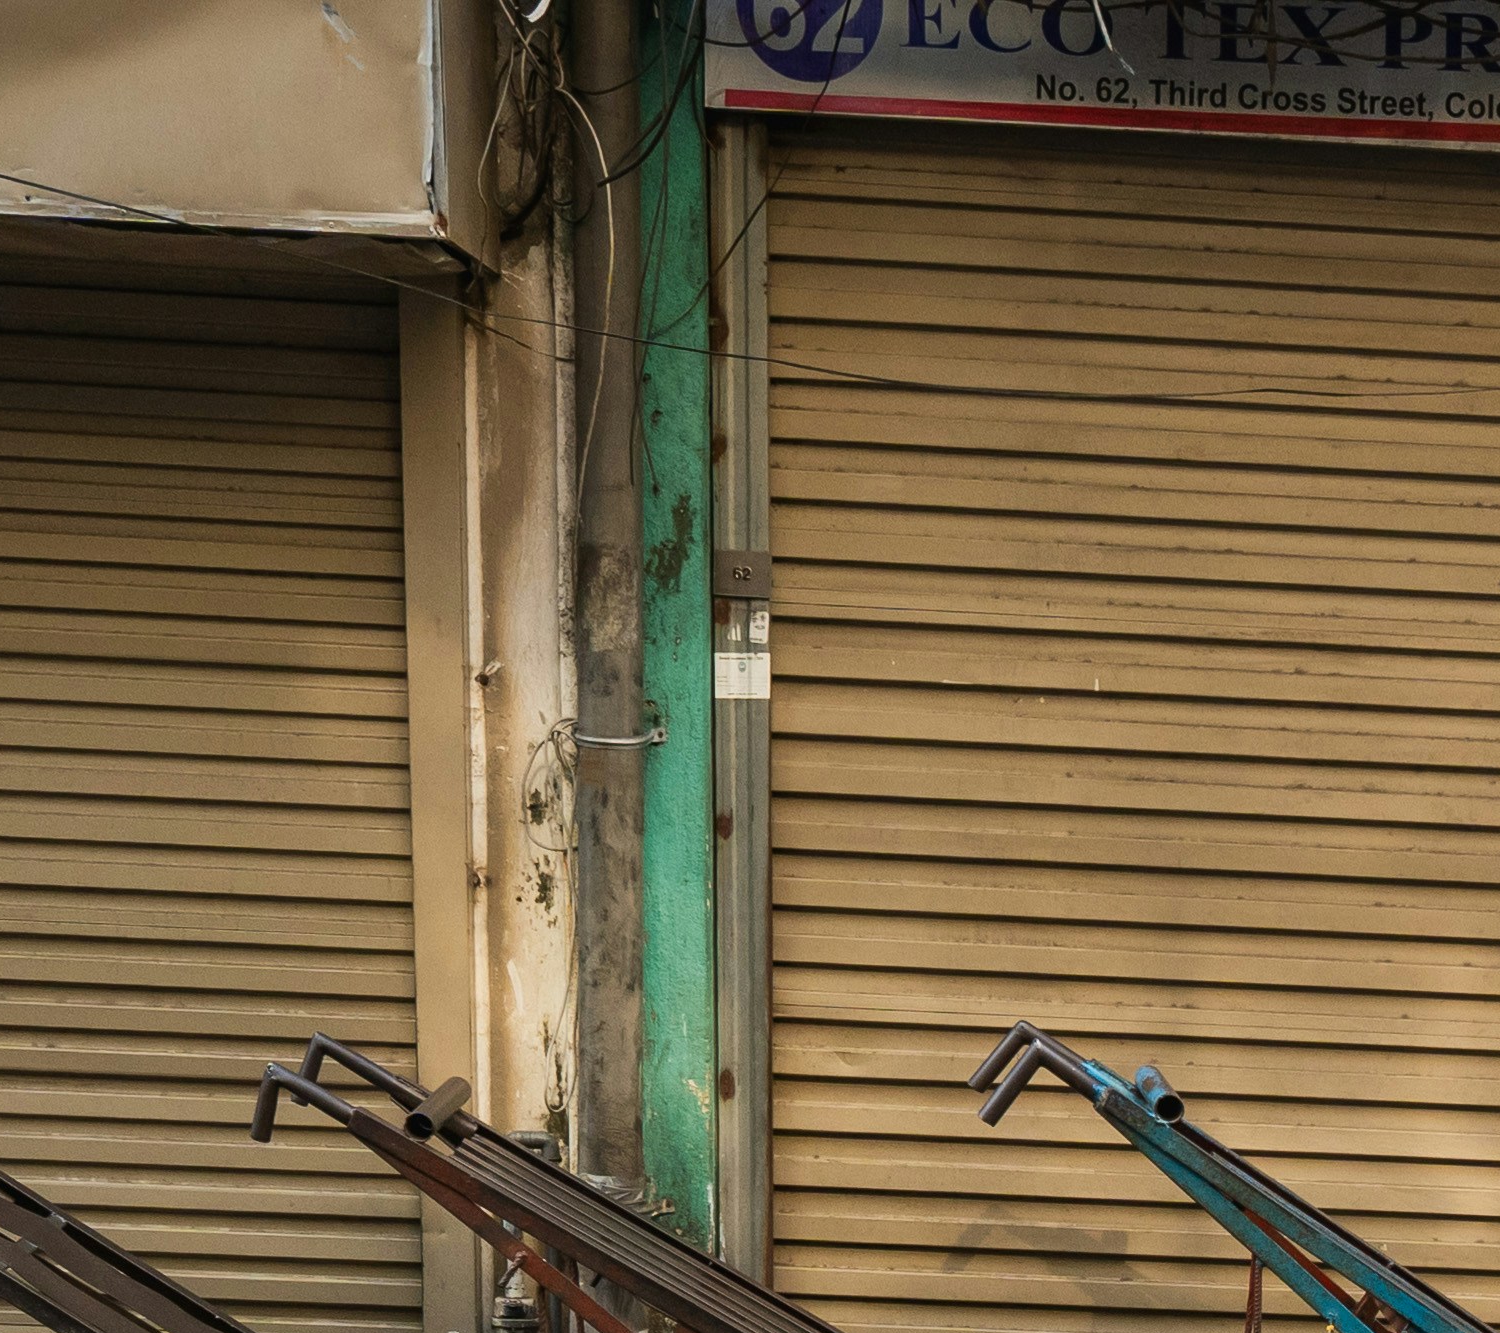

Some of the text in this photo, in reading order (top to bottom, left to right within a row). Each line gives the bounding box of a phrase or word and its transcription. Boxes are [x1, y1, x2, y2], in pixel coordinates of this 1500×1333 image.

[900, 0, 1113, 56] ECO
[1145, 3, 1348, 68] TEX
[1036, 74, 1085, 102] No.
[1096, 77, 1137, 108] 62,
[1149, 79, 1227, 109] Third
[1238, 82, 1326, 113] Cross
[1337, 87, 1434, 121] Street,
[732, 566, 753, 581] 62
